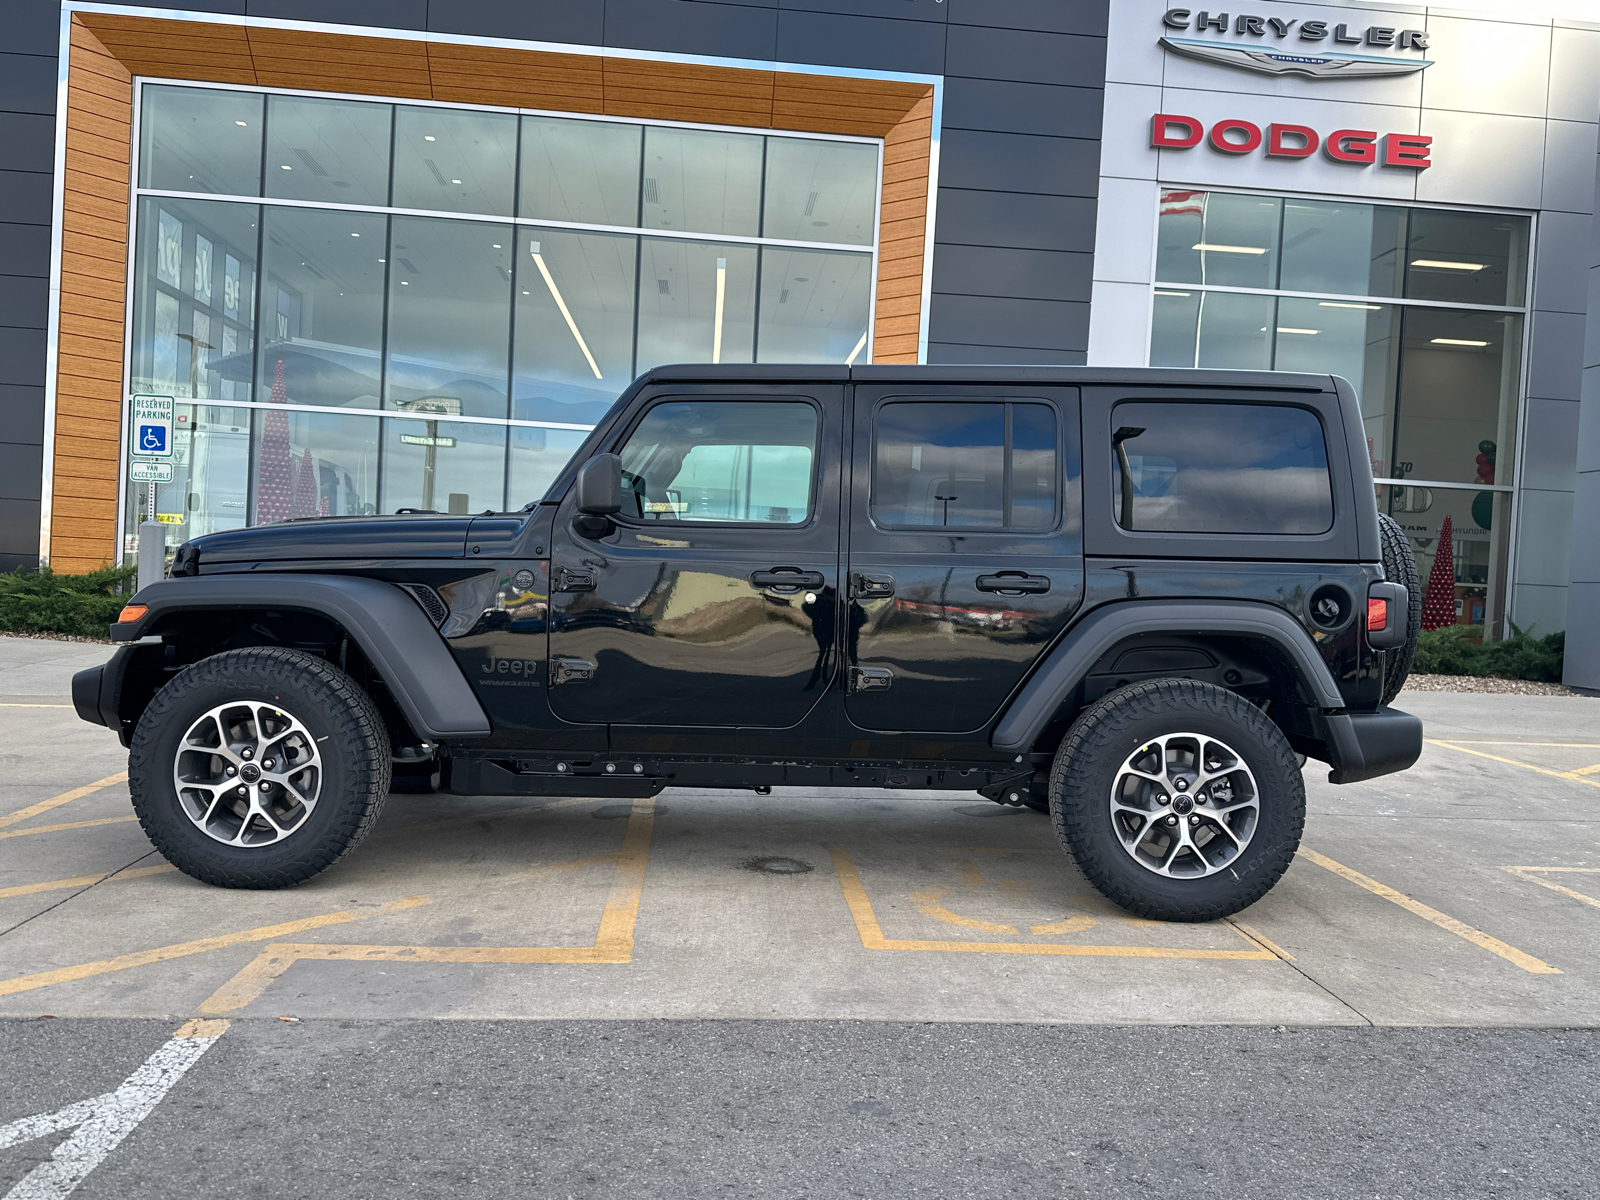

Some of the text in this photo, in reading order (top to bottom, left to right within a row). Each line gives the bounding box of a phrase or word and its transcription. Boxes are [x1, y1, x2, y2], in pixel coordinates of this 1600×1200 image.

[1162, 8, 1431, 50] CHRYSLER
[1271, 54, 1324, 64] CHRYSLER
[1149, 113, 1433, 169] DODGE
[136, 399, 171, 410] RESERVED
[135, 410, 171, 420] PARKING
[449, 424, 535, 441] WAGONER
[1399, 461, 1413, 473] TO
[133, 471, 170, 480] ACCESSIBLE
[1452, 526, 1488, 536] HYUNDAI
[481, 655, 537, 678] Jeep
[478, 679, 531, 687] WRANGLER
